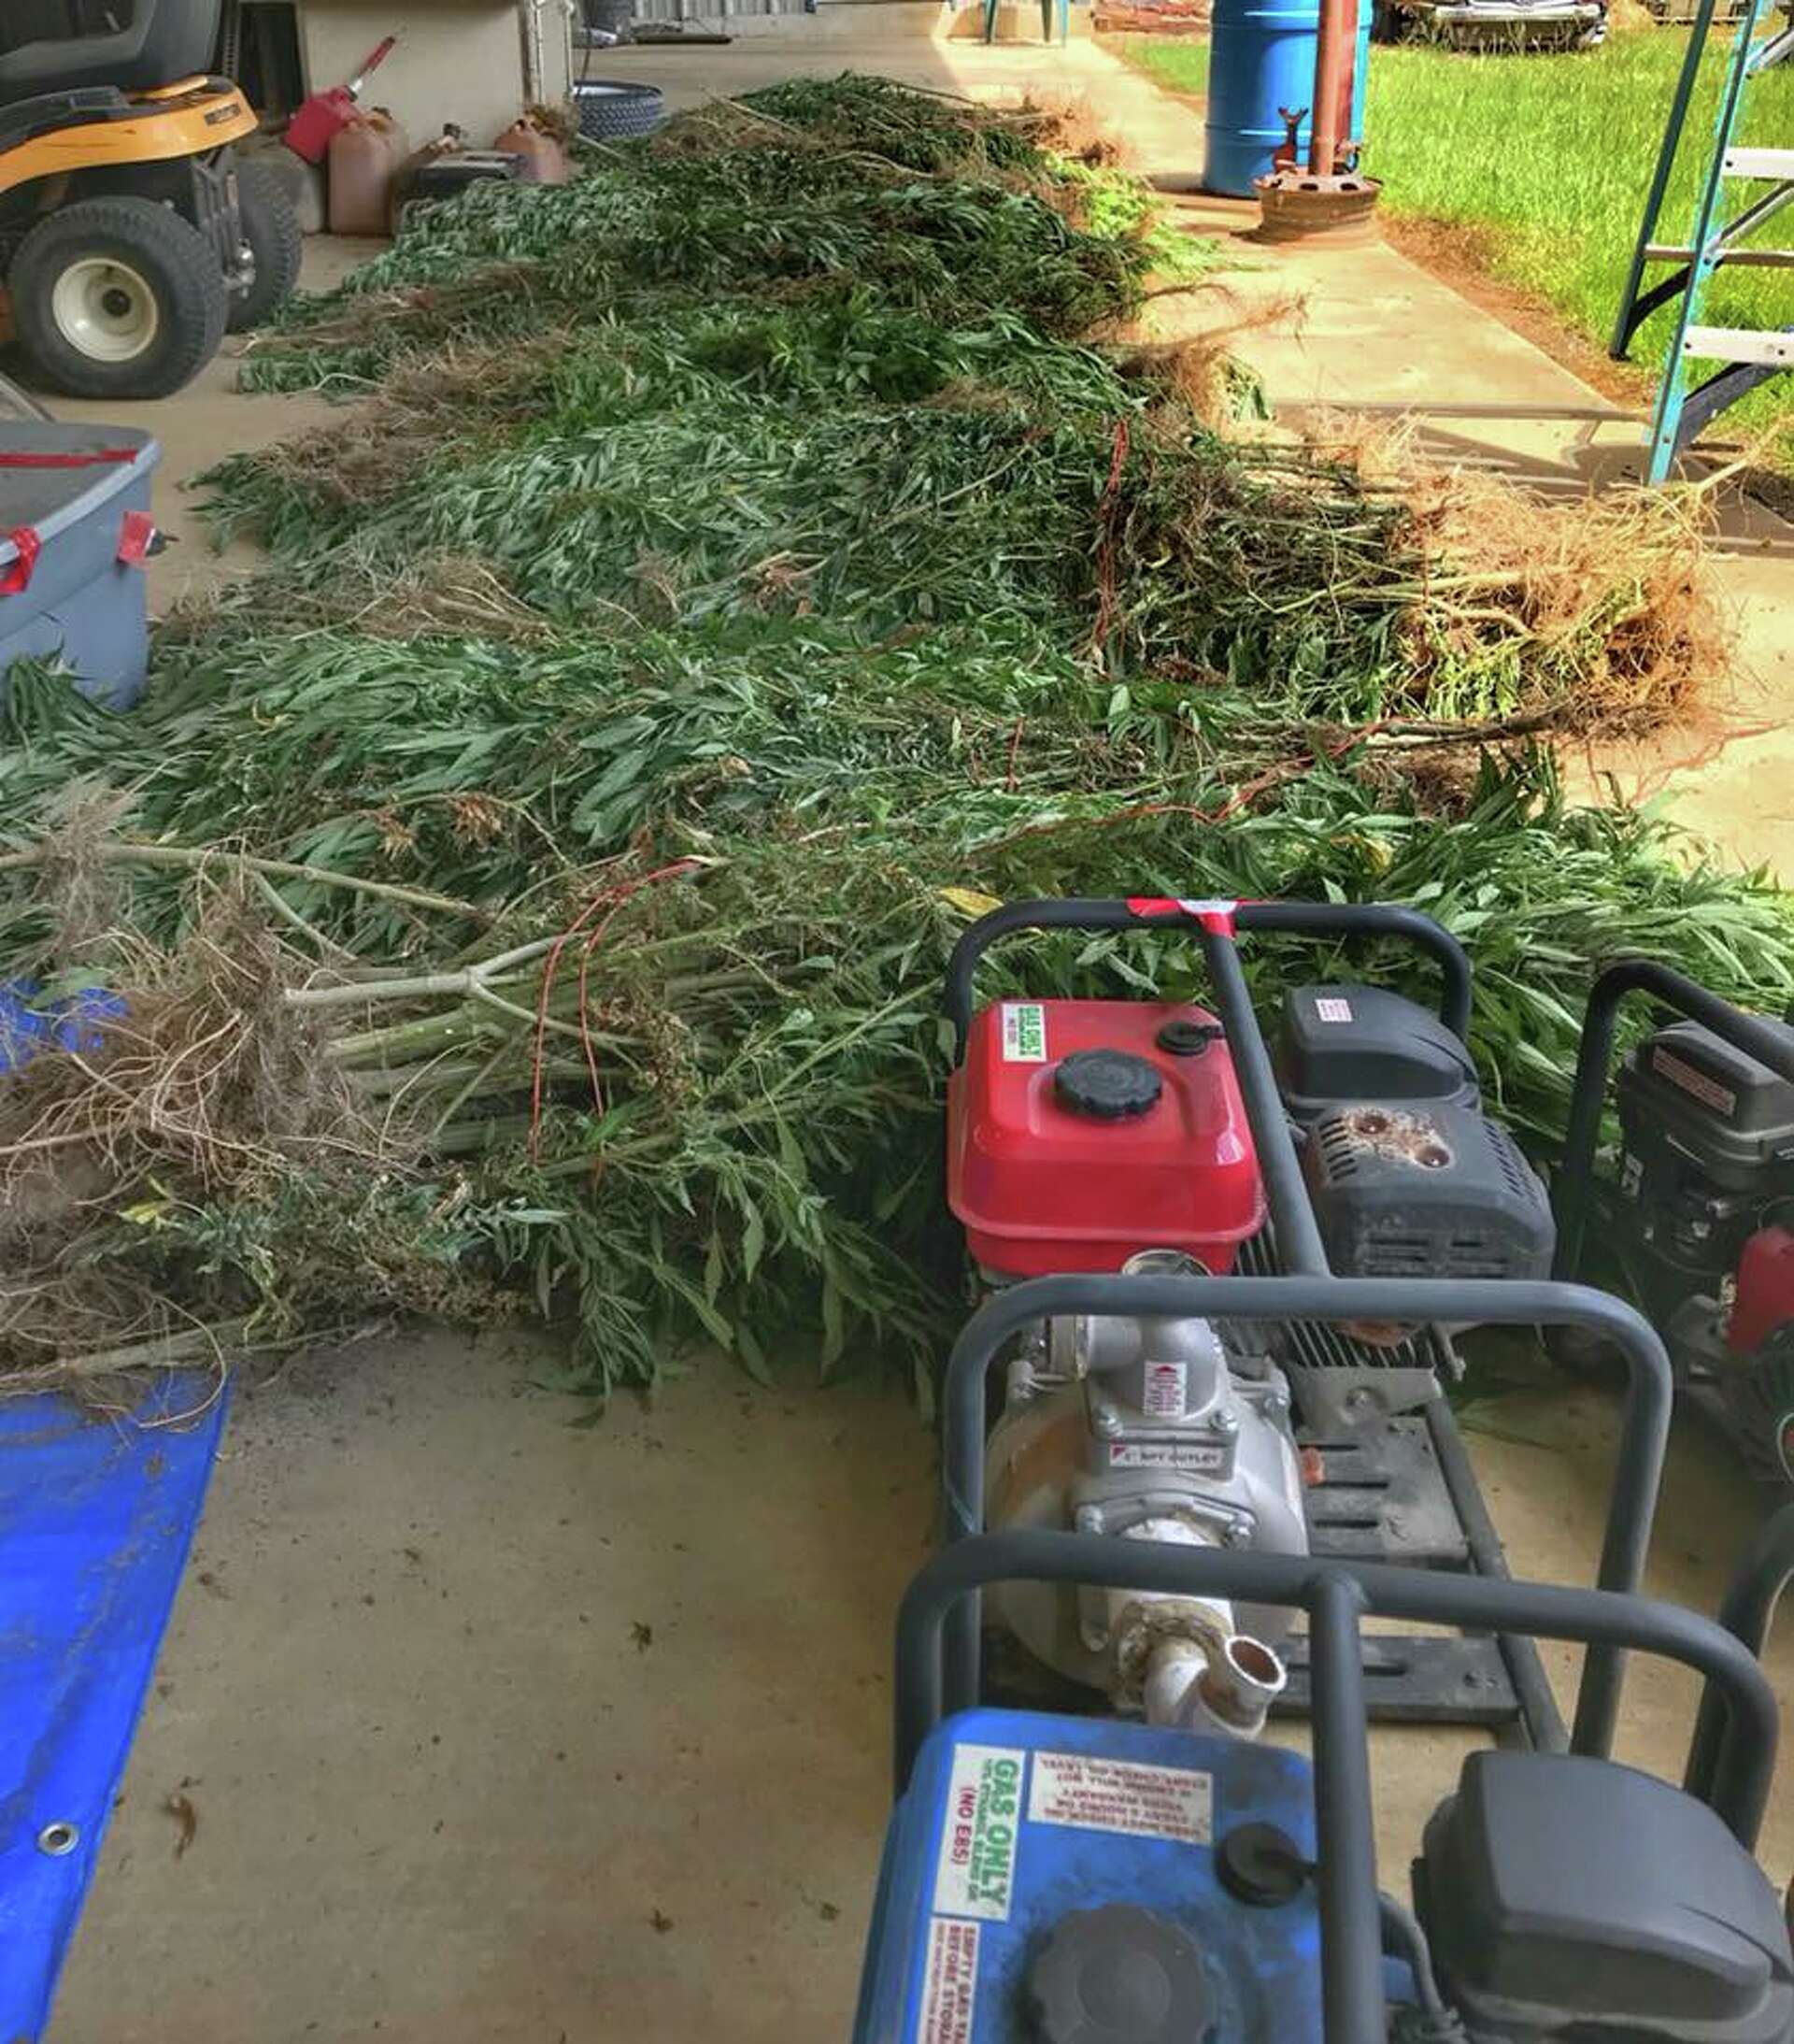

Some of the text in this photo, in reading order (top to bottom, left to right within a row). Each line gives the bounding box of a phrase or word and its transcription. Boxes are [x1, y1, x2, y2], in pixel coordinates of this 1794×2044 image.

[951, 1786, 978, 1865] (NO E85)
[980, 1759, 1018, 1906] GAS ONLY
[944, 1925, 961, 1981] BEFORE
